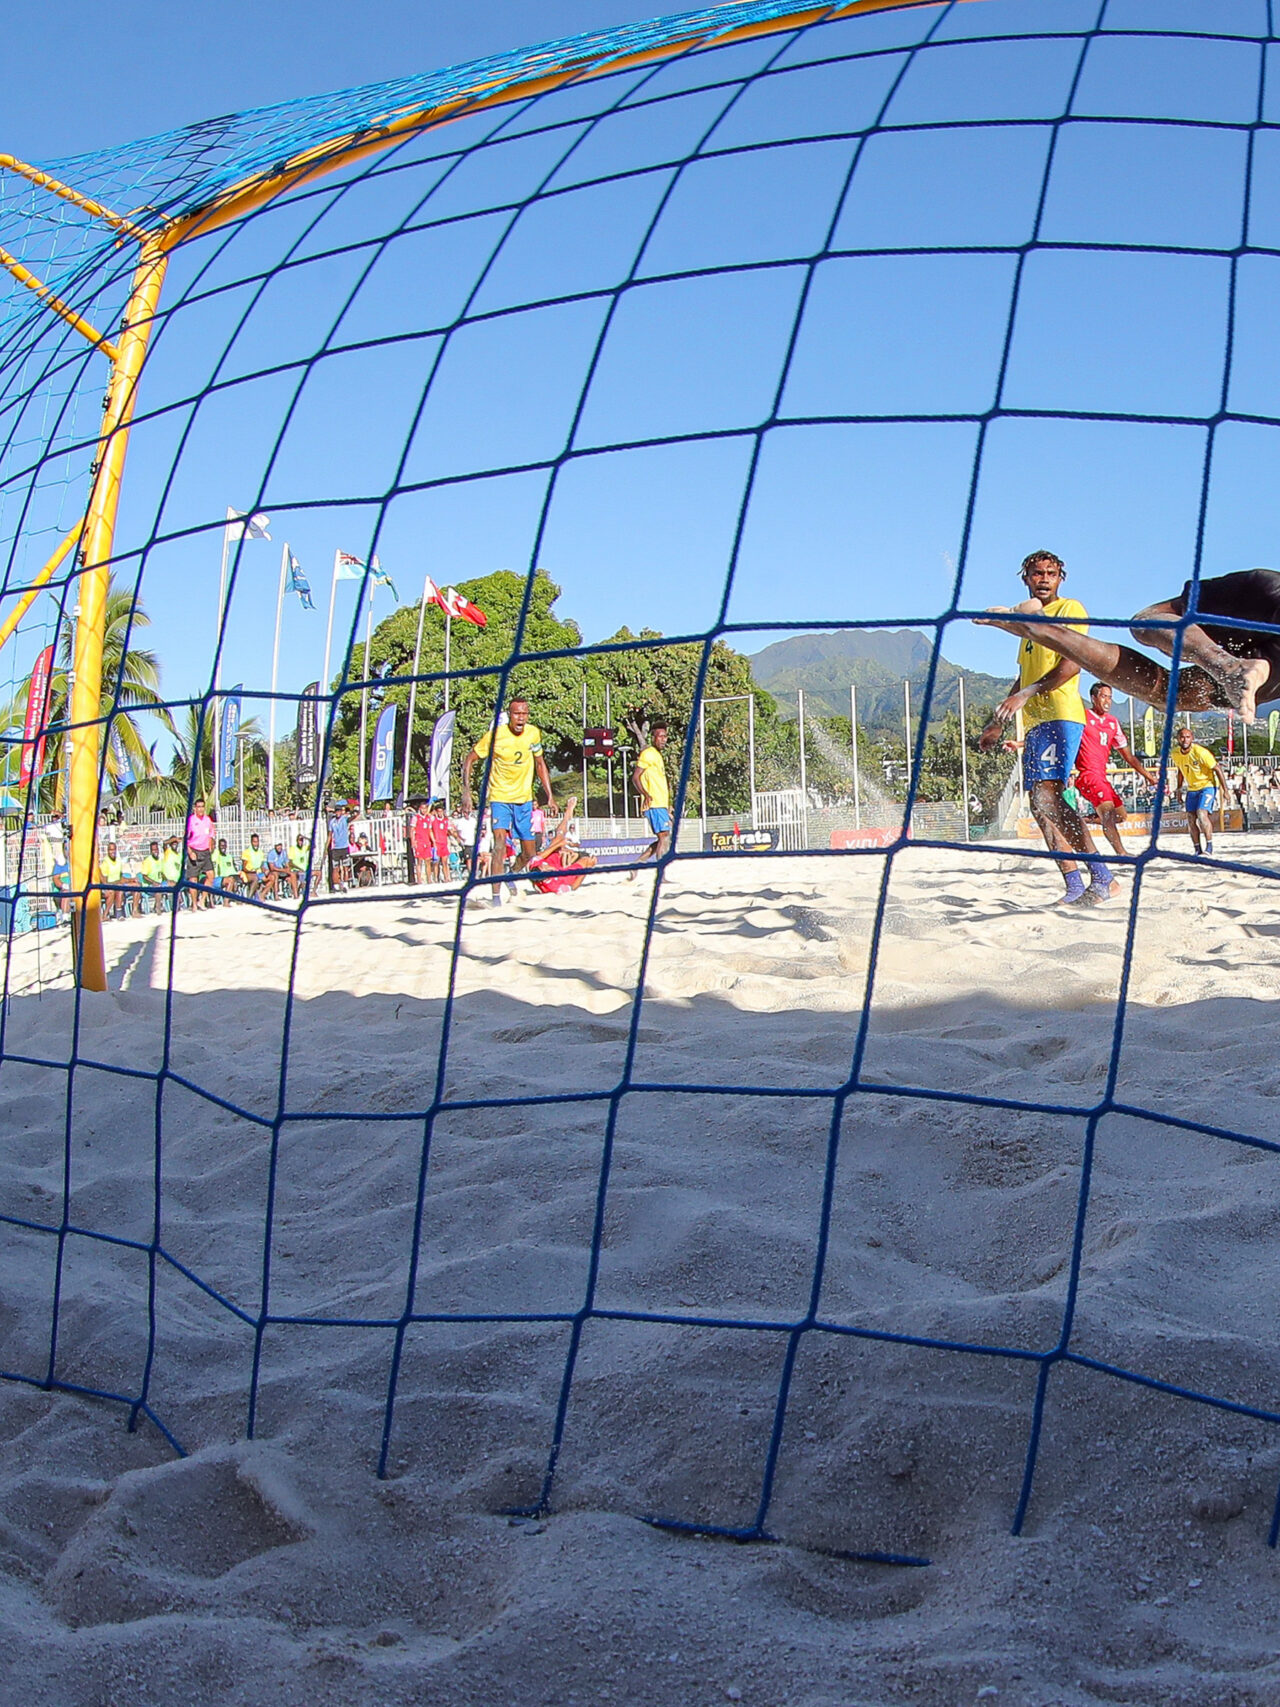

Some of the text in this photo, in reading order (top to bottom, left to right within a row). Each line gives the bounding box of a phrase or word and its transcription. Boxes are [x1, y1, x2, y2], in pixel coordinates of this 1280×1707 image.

[1025, 639, 1033, 654] 4
[376, 743, 386, 771] EDT
[514, 751, 523, 764] 2
[1040, 743, 1059, 766] 4
[1184, 764, 1190, 773] 7
